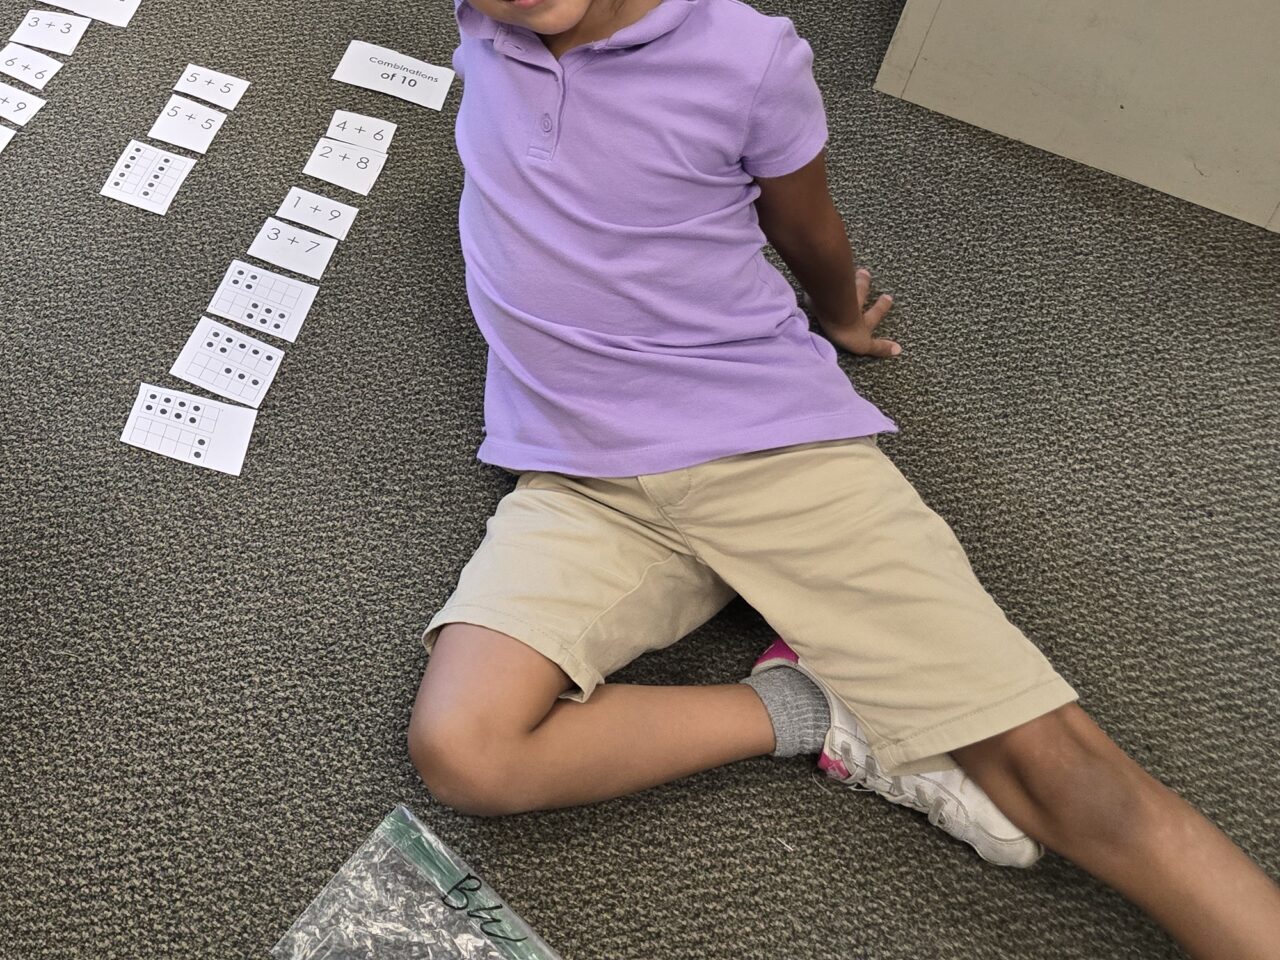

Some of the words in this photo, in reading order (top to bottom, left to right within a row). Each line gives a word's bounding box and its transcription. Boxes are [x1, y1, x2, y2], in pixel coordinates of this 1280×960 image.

[26, 15, 41, 28] 3
[59, 22, 73, 34] 3
[4, 57, 18, 67] 6
[34, 69, 48, 80] 6
[368, 56, 439, 83] Combinations
[380, 71, 398, 81] of
[400, 74, 418, 89] 10
[185, 71, 201, 84] 5
[219, 82, 234, 94] 5
[13, 101, 27, 113] 9
[165, 104, 182, 119] 5
[200, 118, 216, 130] 5
[335, 120, 348, 132] 4
[372, 129, 384, 141] 6
[318, 145, 333, 159] 2
[356, 156, 370, 170] 8
[293, 196, 302, 209] 1
[328, 209, 342, 221] 9
[266, 227, 281, 241] 3
[304, 240, 321, 253] 7
